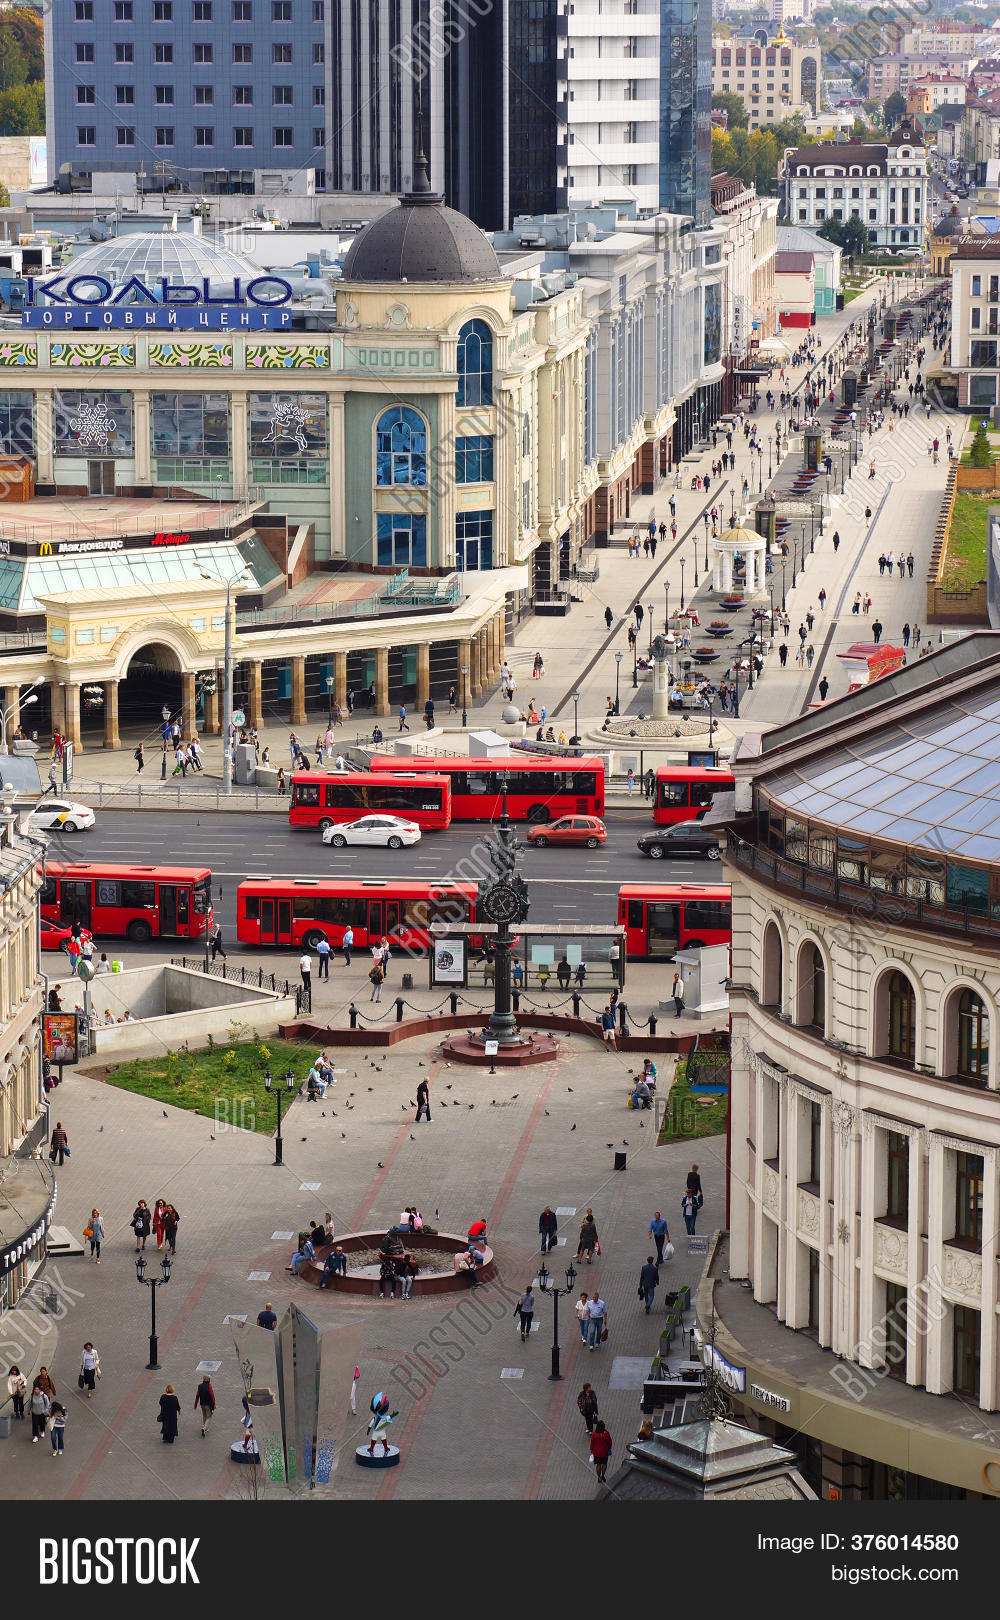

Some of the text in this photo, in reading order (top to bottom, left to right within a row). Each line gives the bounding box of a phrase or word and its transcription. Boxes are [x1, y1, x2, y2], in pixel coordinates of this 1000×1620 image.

[26, 274, 294, 307] КОЛЬЦО
[23, 309, 291, 327] ТОРГОВЫЙ ЦЕНТР
[100, 887, 116, 902] 63
[750, 1384, 790, 1412] ПЕКАРНЯ
